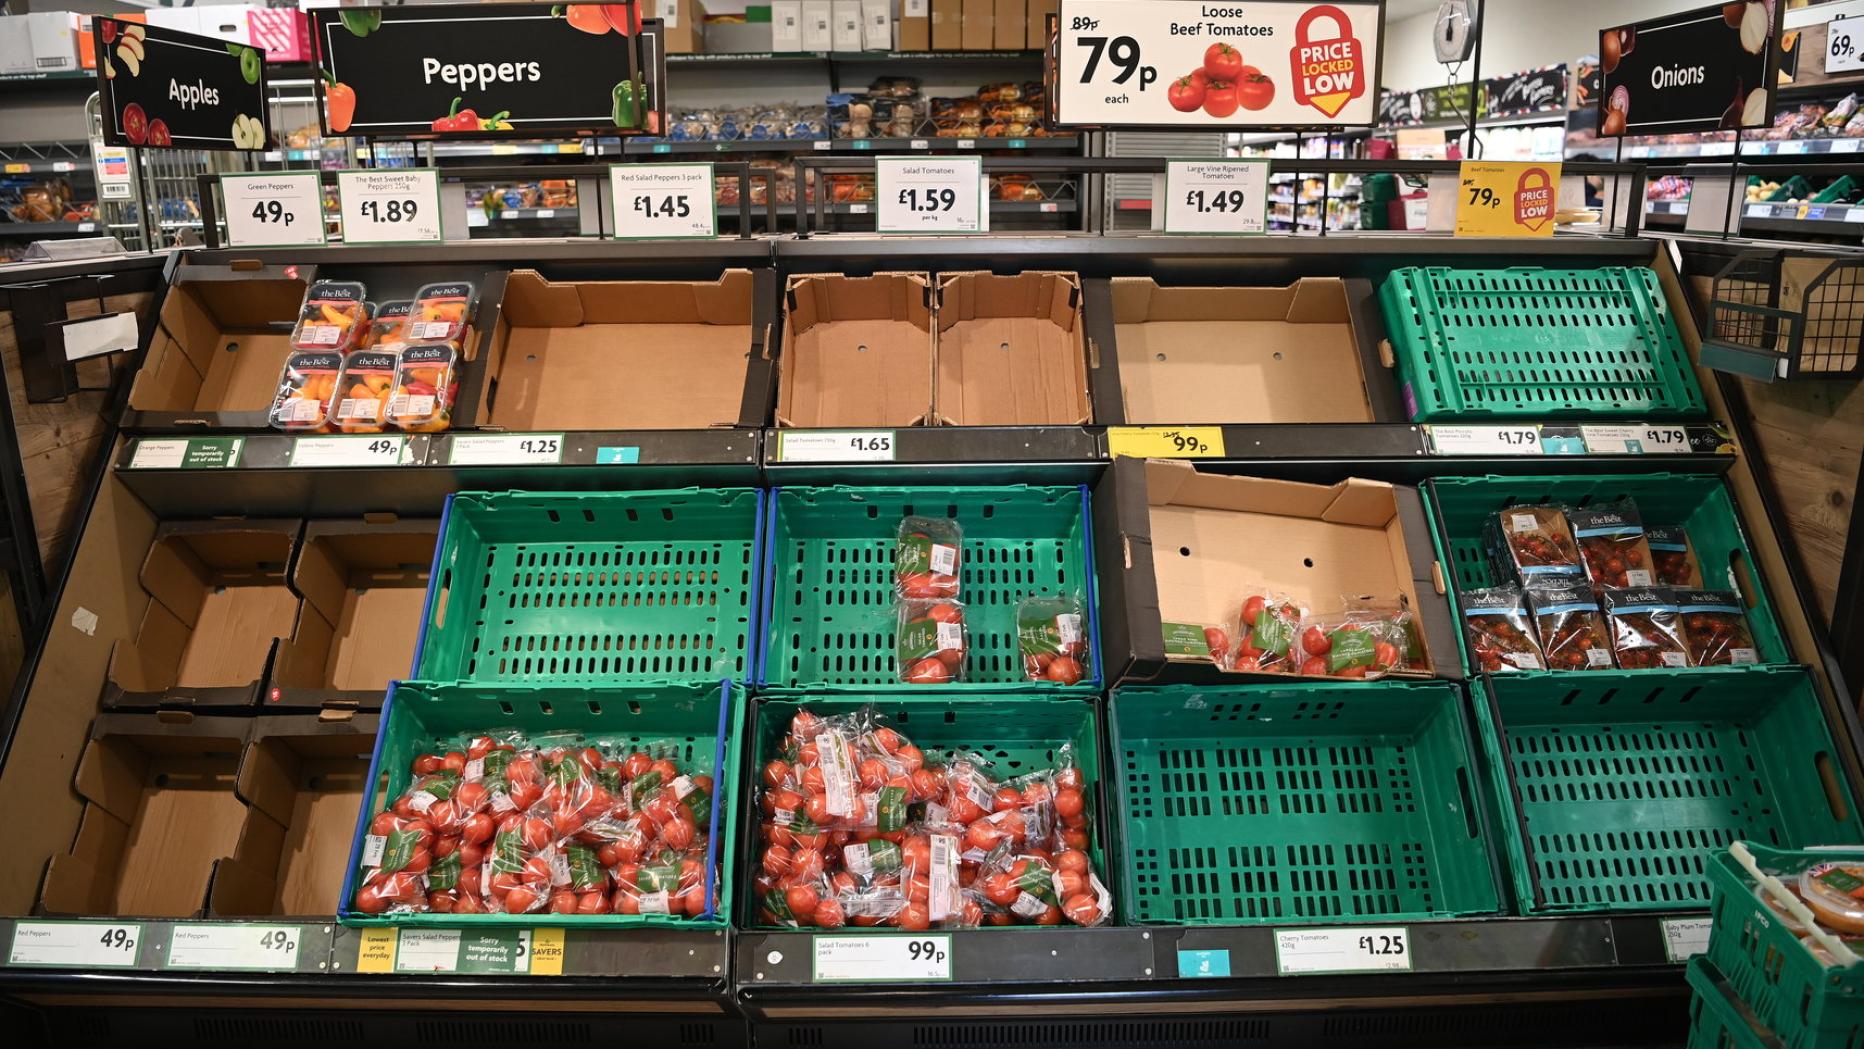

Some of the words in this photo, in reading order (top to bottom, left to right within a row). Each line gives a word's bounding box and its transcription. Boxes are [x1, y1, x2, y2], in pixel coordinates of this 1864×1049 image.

[1202, 5, 1243, 18] Loose
[1072, 17, 1099, 31] 89p
[1170, 23, 1203, 36] Beef
[1206, 23, 1274, 37] Tomatoes
[1831, 34, 1855, 58] 69p
[1300, 42, 1353, 64] PRICE
[1077, 35, 1157, 91] 79p
[1302, 59, 1354, 77] LOCKED
[423, 58, 541, 92] Peppers
[1651, 63, 1704, 90] Onions
[1303, 71, 1354, 96] LOW
[169, 78, 220, 110] Apples
[1105, 93, 1129, 104] each
[1222, 165, 1249, 173] Ripened
[268, 184, 294, 192] Peppers
[367, 183, 394, 191] Peppers
[898, 188, 956, 212] £1.59
[1186, 190, 1244, 213] £1.49
[1470, 188, 1500, 209] 79p
[1520, 190, 1548, 202] PRICE
[634, 195, 690, 218] £1.45
[1520, 199, 1548, 208] LOCKED
[252, 200, 294, 226] 49p
[361, 200, 418, 223] £1.89
[1521, 206, 1548, 218] LOW
[322, 289, 334, 298] the
[334, 289, 352, 298] Best
[431, 288, 442, 296] the
[444, 287, 460, 296] Best
[388, 306, 400, 314] the
[411, 350, 423, 358] the
[424, 350, 441, 358] Best
[300, 358, 313, 366] the
[314, 358, 330, 366] Best
[359, 358, 371, 366] the
[372, 358, 390, 366] Best
[1498, 431, 1536, 445] £1.79
[1648, 430, 1684, 444] £1.79
[368, 440, 398, 455] 49p
[520, 440, 558, 453] £1.25
[851, 438, 890, 450] £1.65
[1174, 436, 1208, 454] 99p
[1590, 516, 1603, 524] the
[1604, 515, 1622, 524] Best
[1626, 594, 1638, 602] the
[1640, 593, 1656, 602] Best
[29, 930, 51, 938] Peppers
[100, 928, 134, 951] 49p
[187, 932, 210, 940] Peppers
[480, 936, 499, 944] Sorry
[260, 930, 295, 954] 49p
[1360, 936, 1404, 954] £1.25
[468, 945, 508, 954] temporarily
[532, 948, 562, 956] SAVERS
[908, 941, 945, 963] 99p
[488, 954, 508, 962] stock
